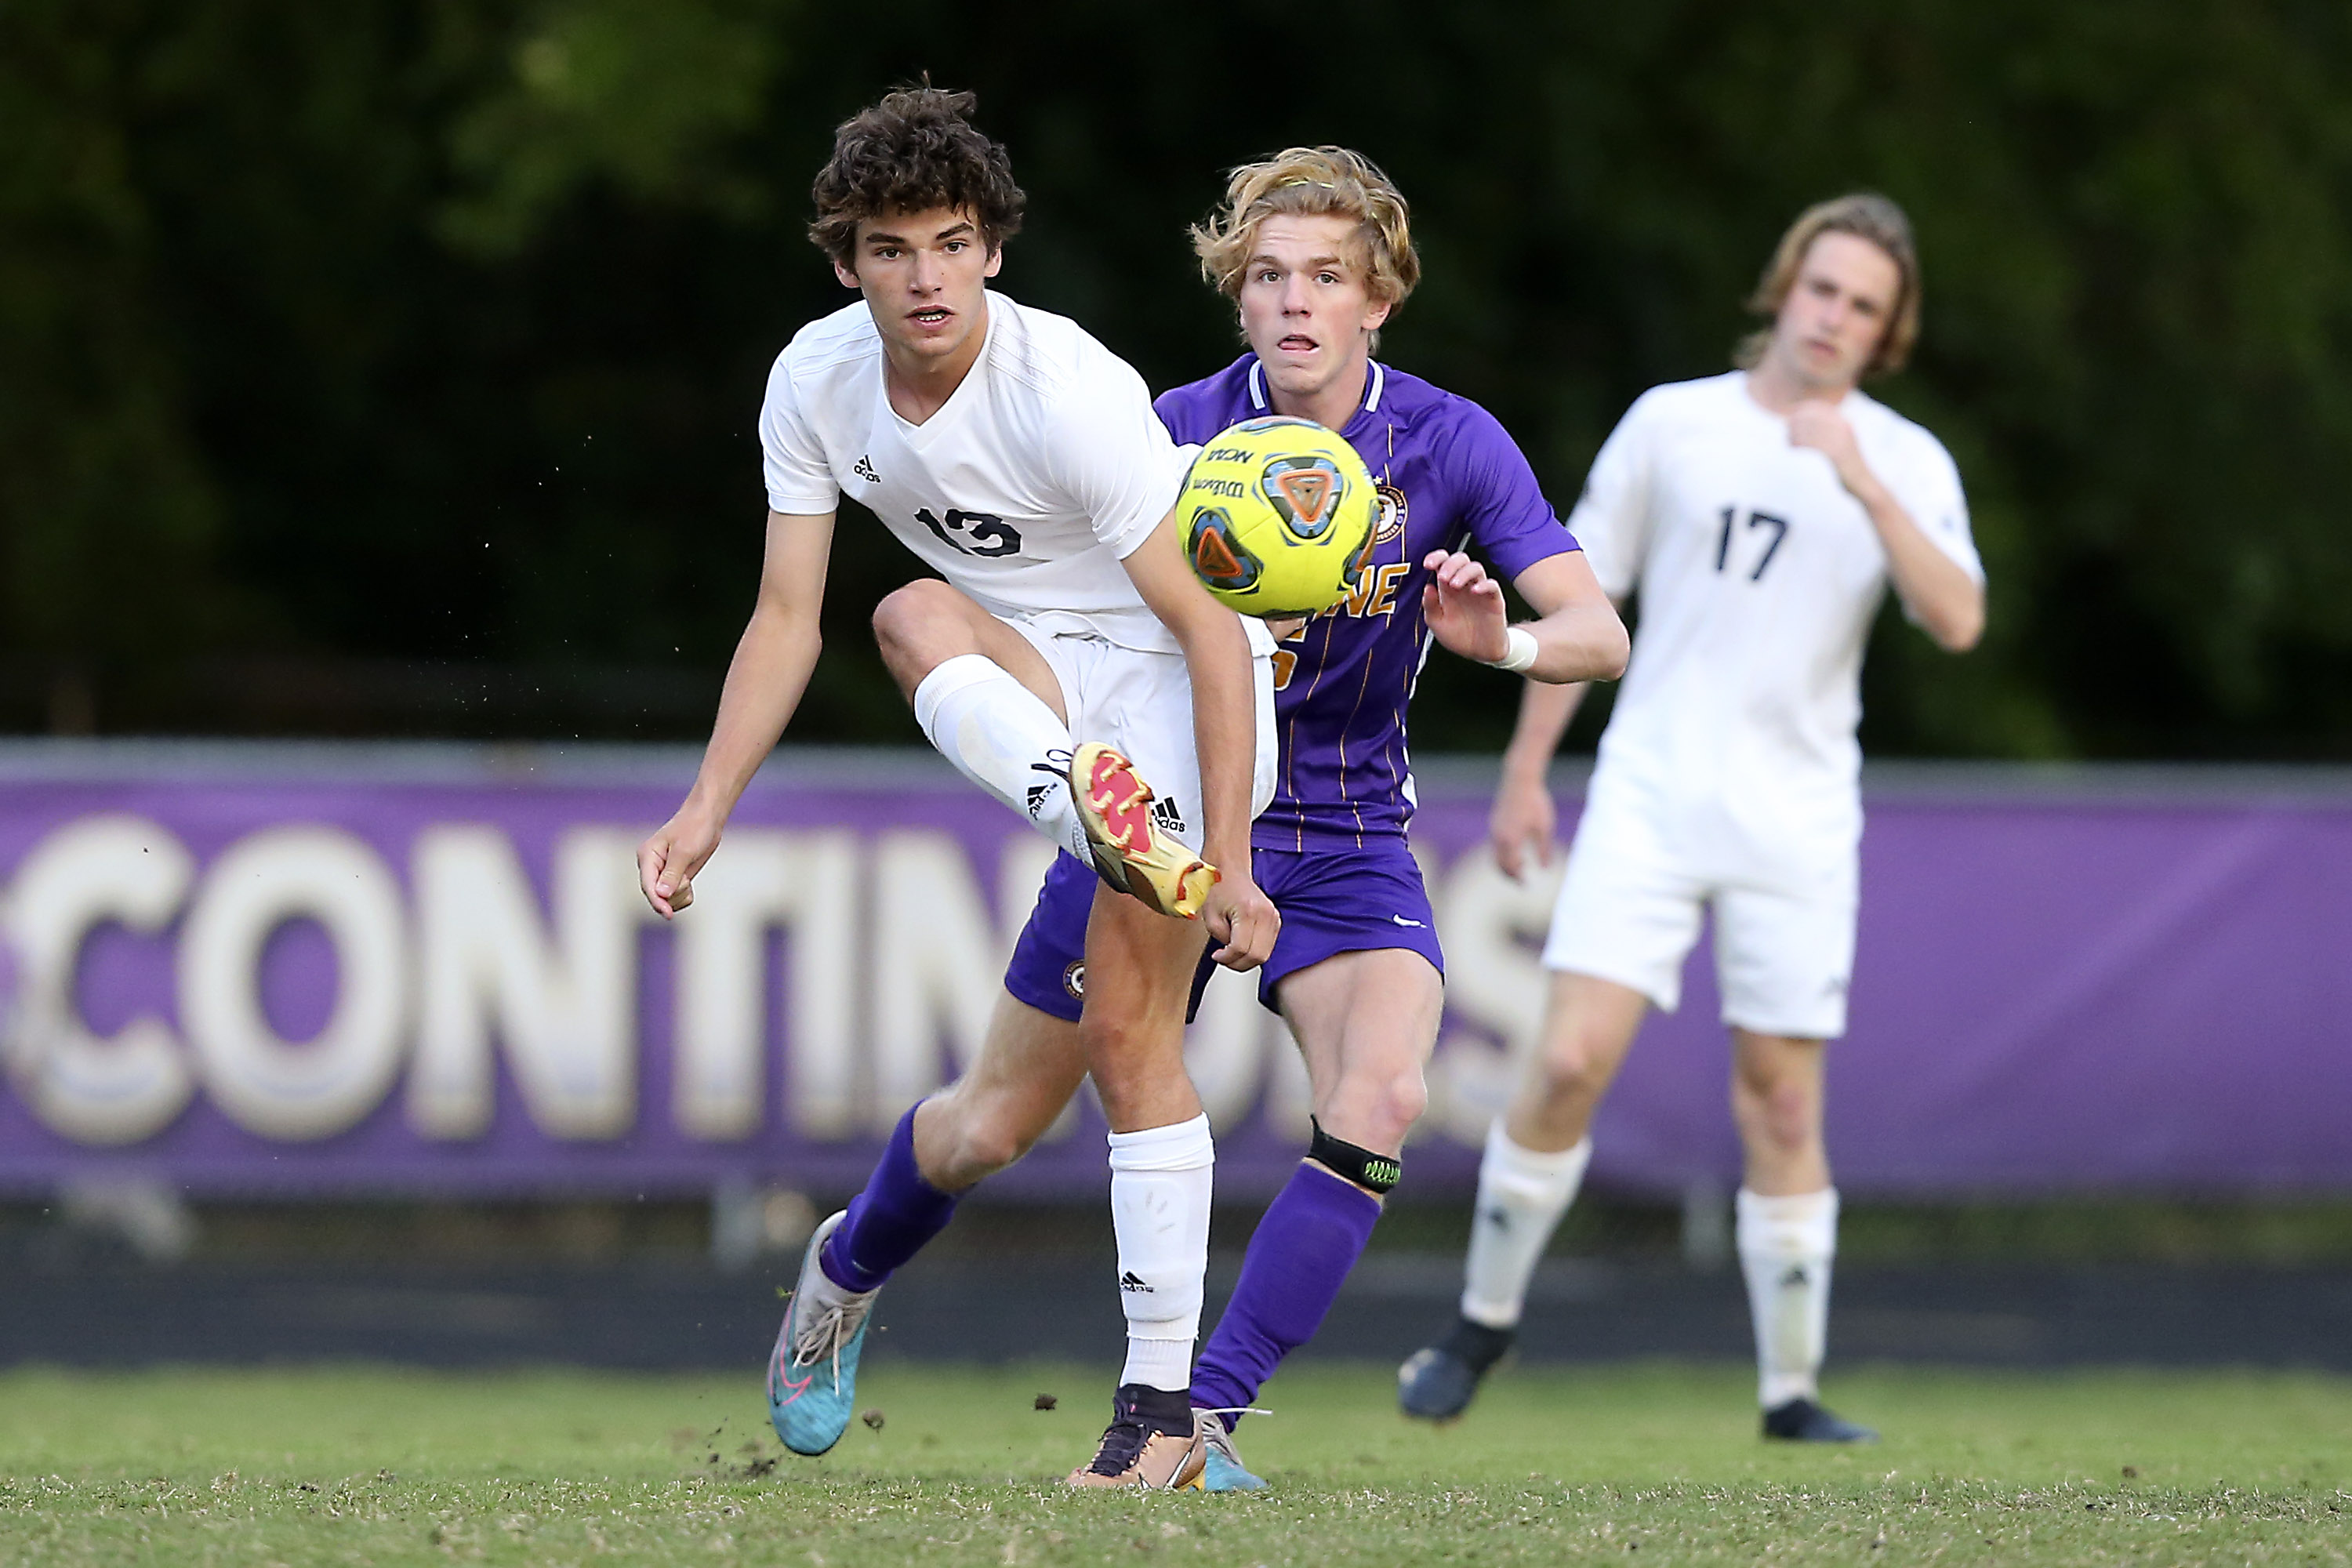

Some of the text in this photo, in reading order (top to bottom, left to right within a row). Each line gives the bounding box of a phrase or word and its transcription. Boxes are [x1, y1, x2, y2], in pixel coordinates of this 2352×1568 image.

[1207, 448, 1254, 463] NCAA
[1193, 479, 1243, 498] Wilson
[914, 508, 1022, 557] 13
[1715, 505, 1788, 581] 17
